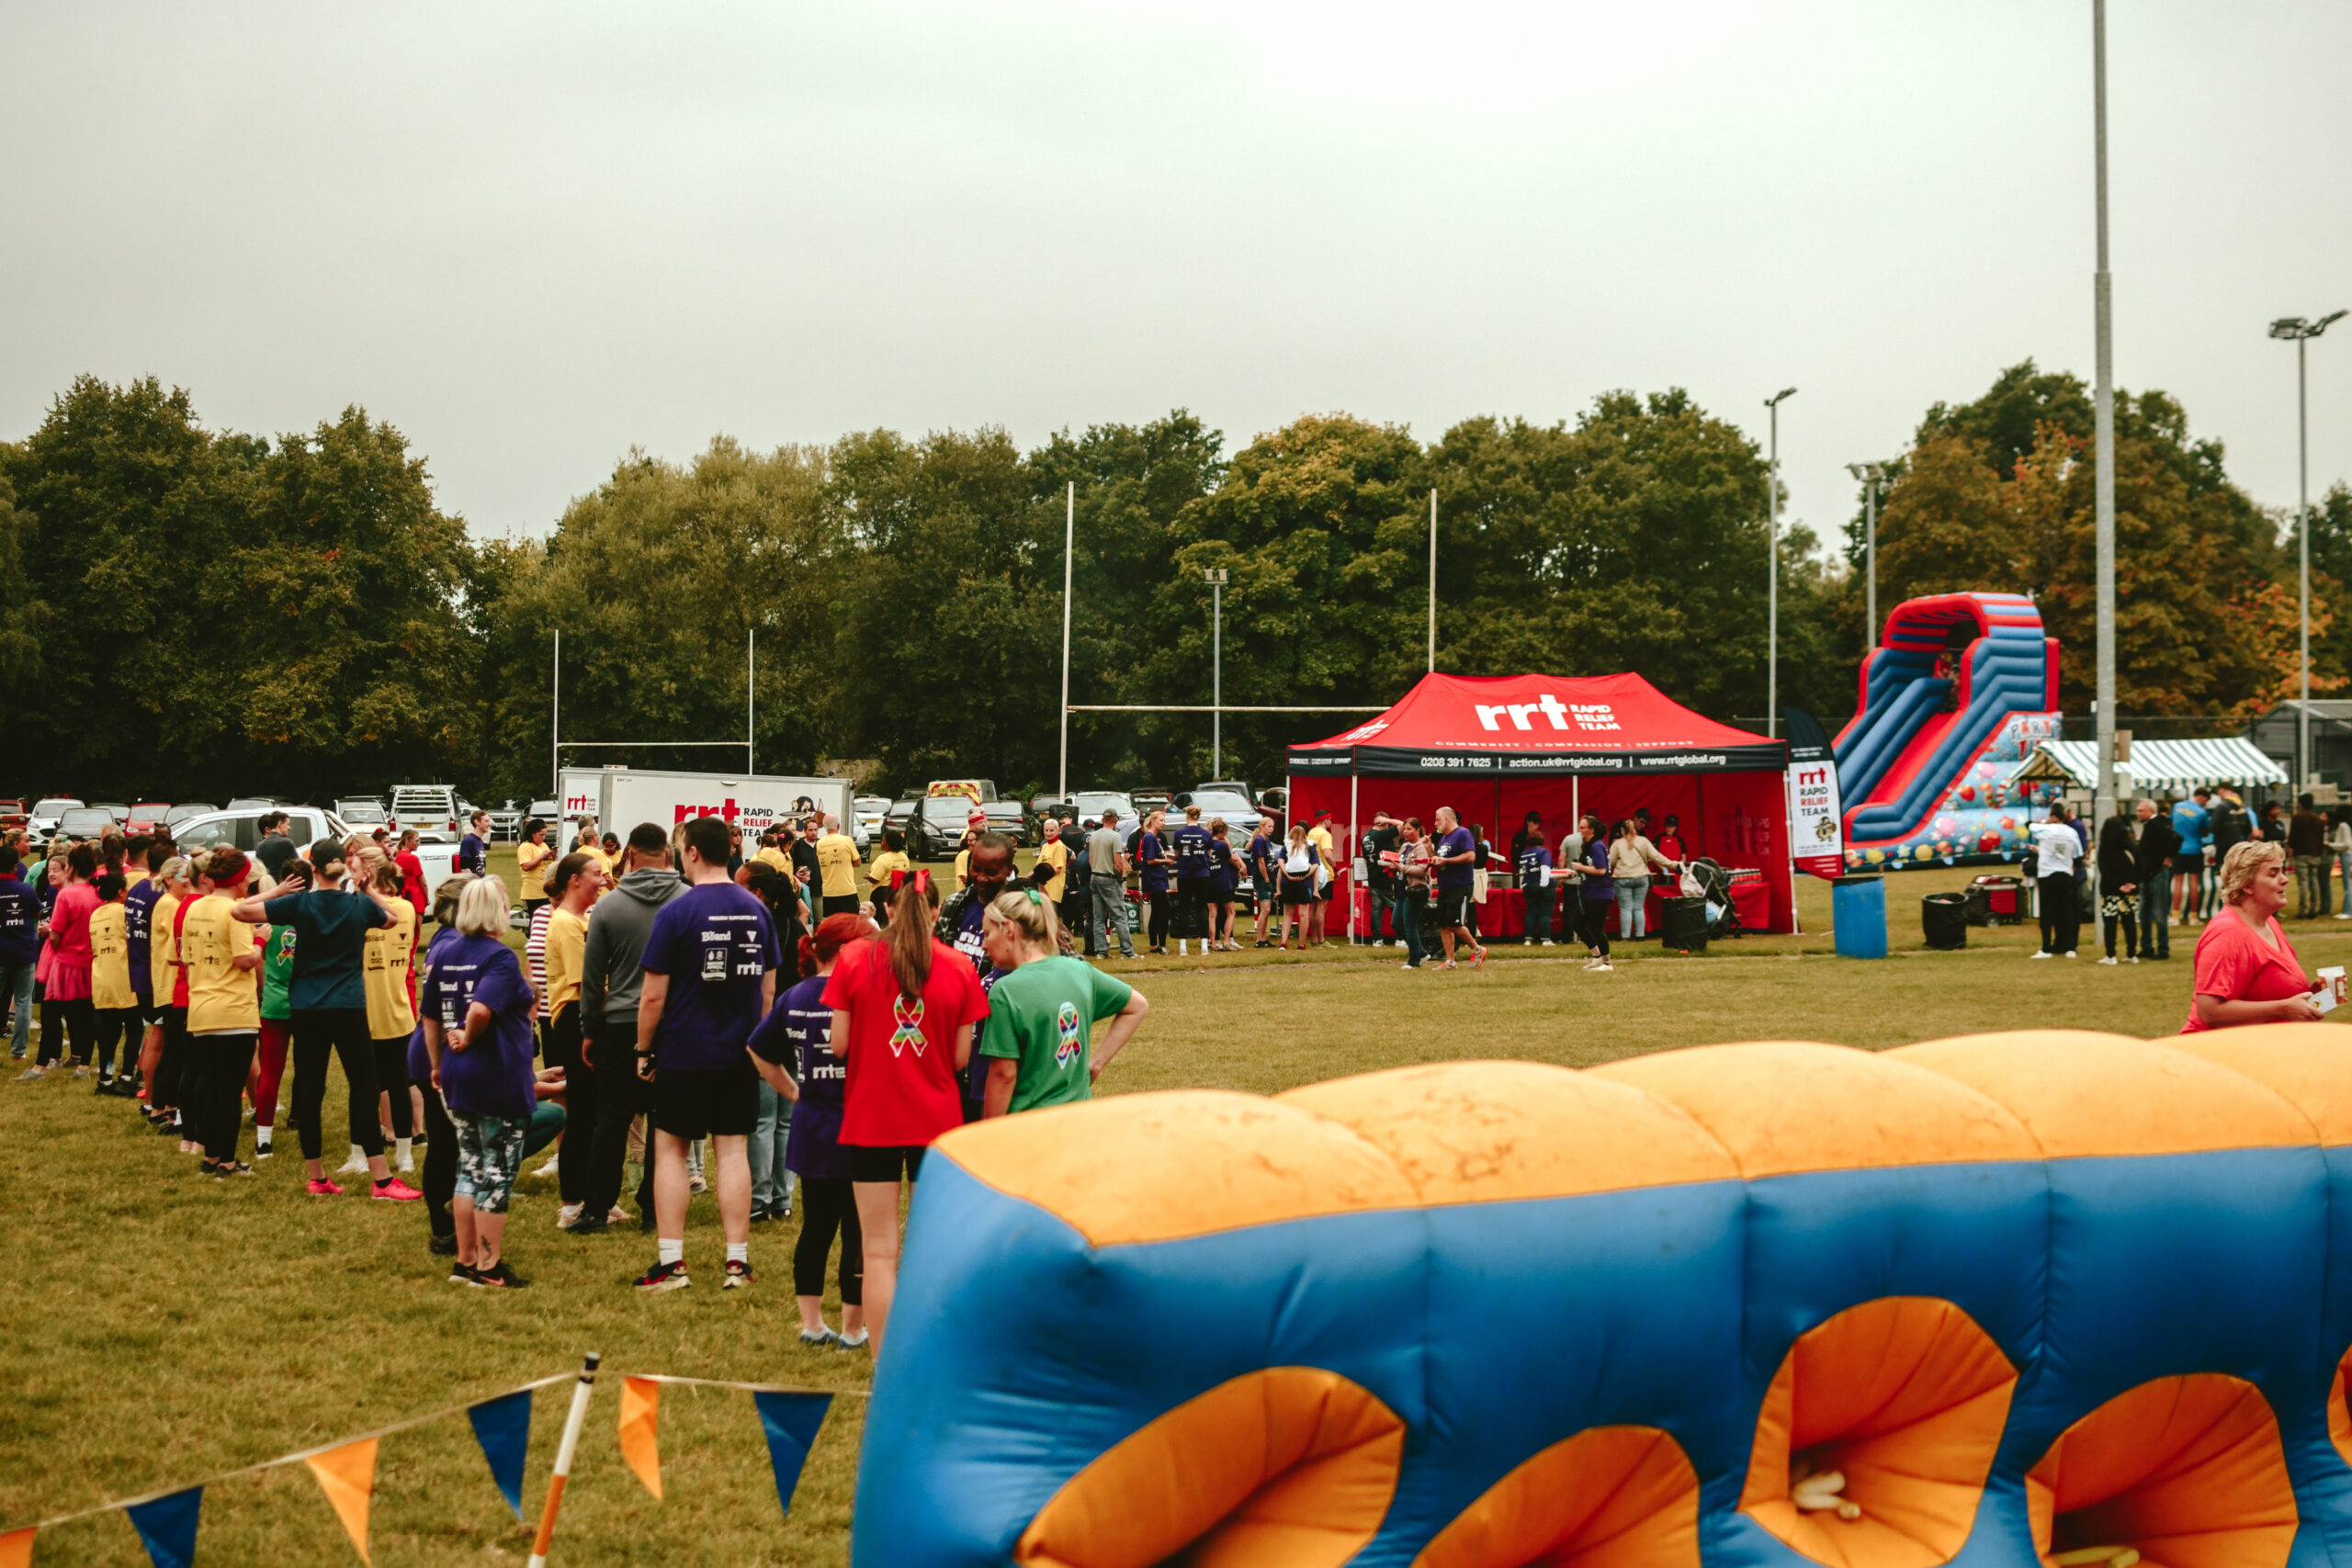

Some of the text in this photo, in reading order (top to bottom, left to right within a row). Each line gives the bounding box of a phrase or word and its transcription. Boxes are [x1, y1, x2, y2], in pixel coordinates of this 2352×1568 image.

[1475, 694, 1569, 731] rrt
[1570, 704, 1612, 714] RAPID
[1574, 714, 1616, 723] RELIEF
[1577, 723, 1623, 731] TEAM
[1420, 754, 1726, 769] 0208 391 7625 action.uk@rrtglobal.org www.rrtglobal.org
[1799, 767, 1826, 785] rrt
[1800, 786, 1828, 796] RAPID
[568, 795, 586, 810] rrt
[1801, 796, 1828, 807] RELIEF
[743, 807, 774, 817] RAPID
[1801, 807, 1829, 817] TEAM
[743, 818, 773, 827] RELIEF
[743, 829, 766, 837] TEA
